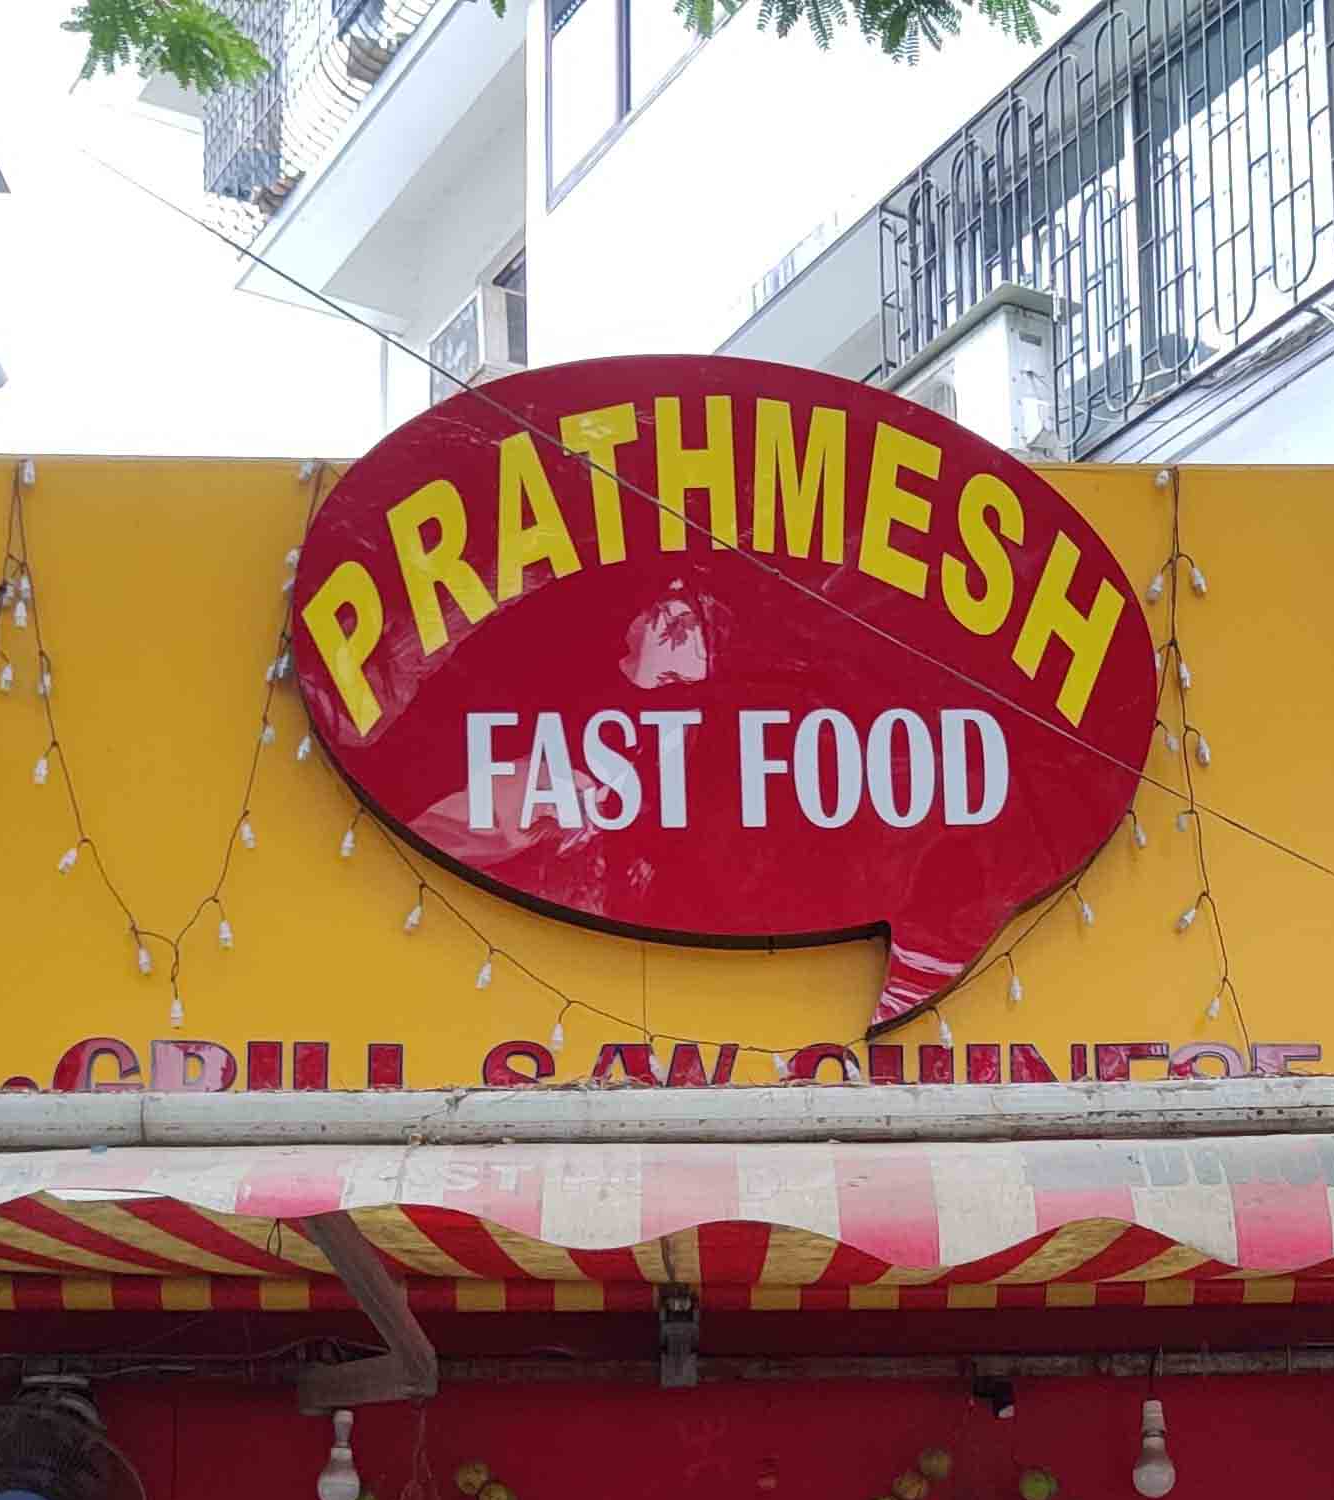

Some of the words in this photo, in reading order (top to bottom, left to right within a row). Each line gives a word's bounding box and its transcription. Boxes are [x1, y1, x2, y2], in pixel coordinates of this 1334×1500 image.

[301, 395, 1125, 737] PRATHMESH
[467, 710, 701, 830] FAST
[739, 708, 1010, 829] FOOD
